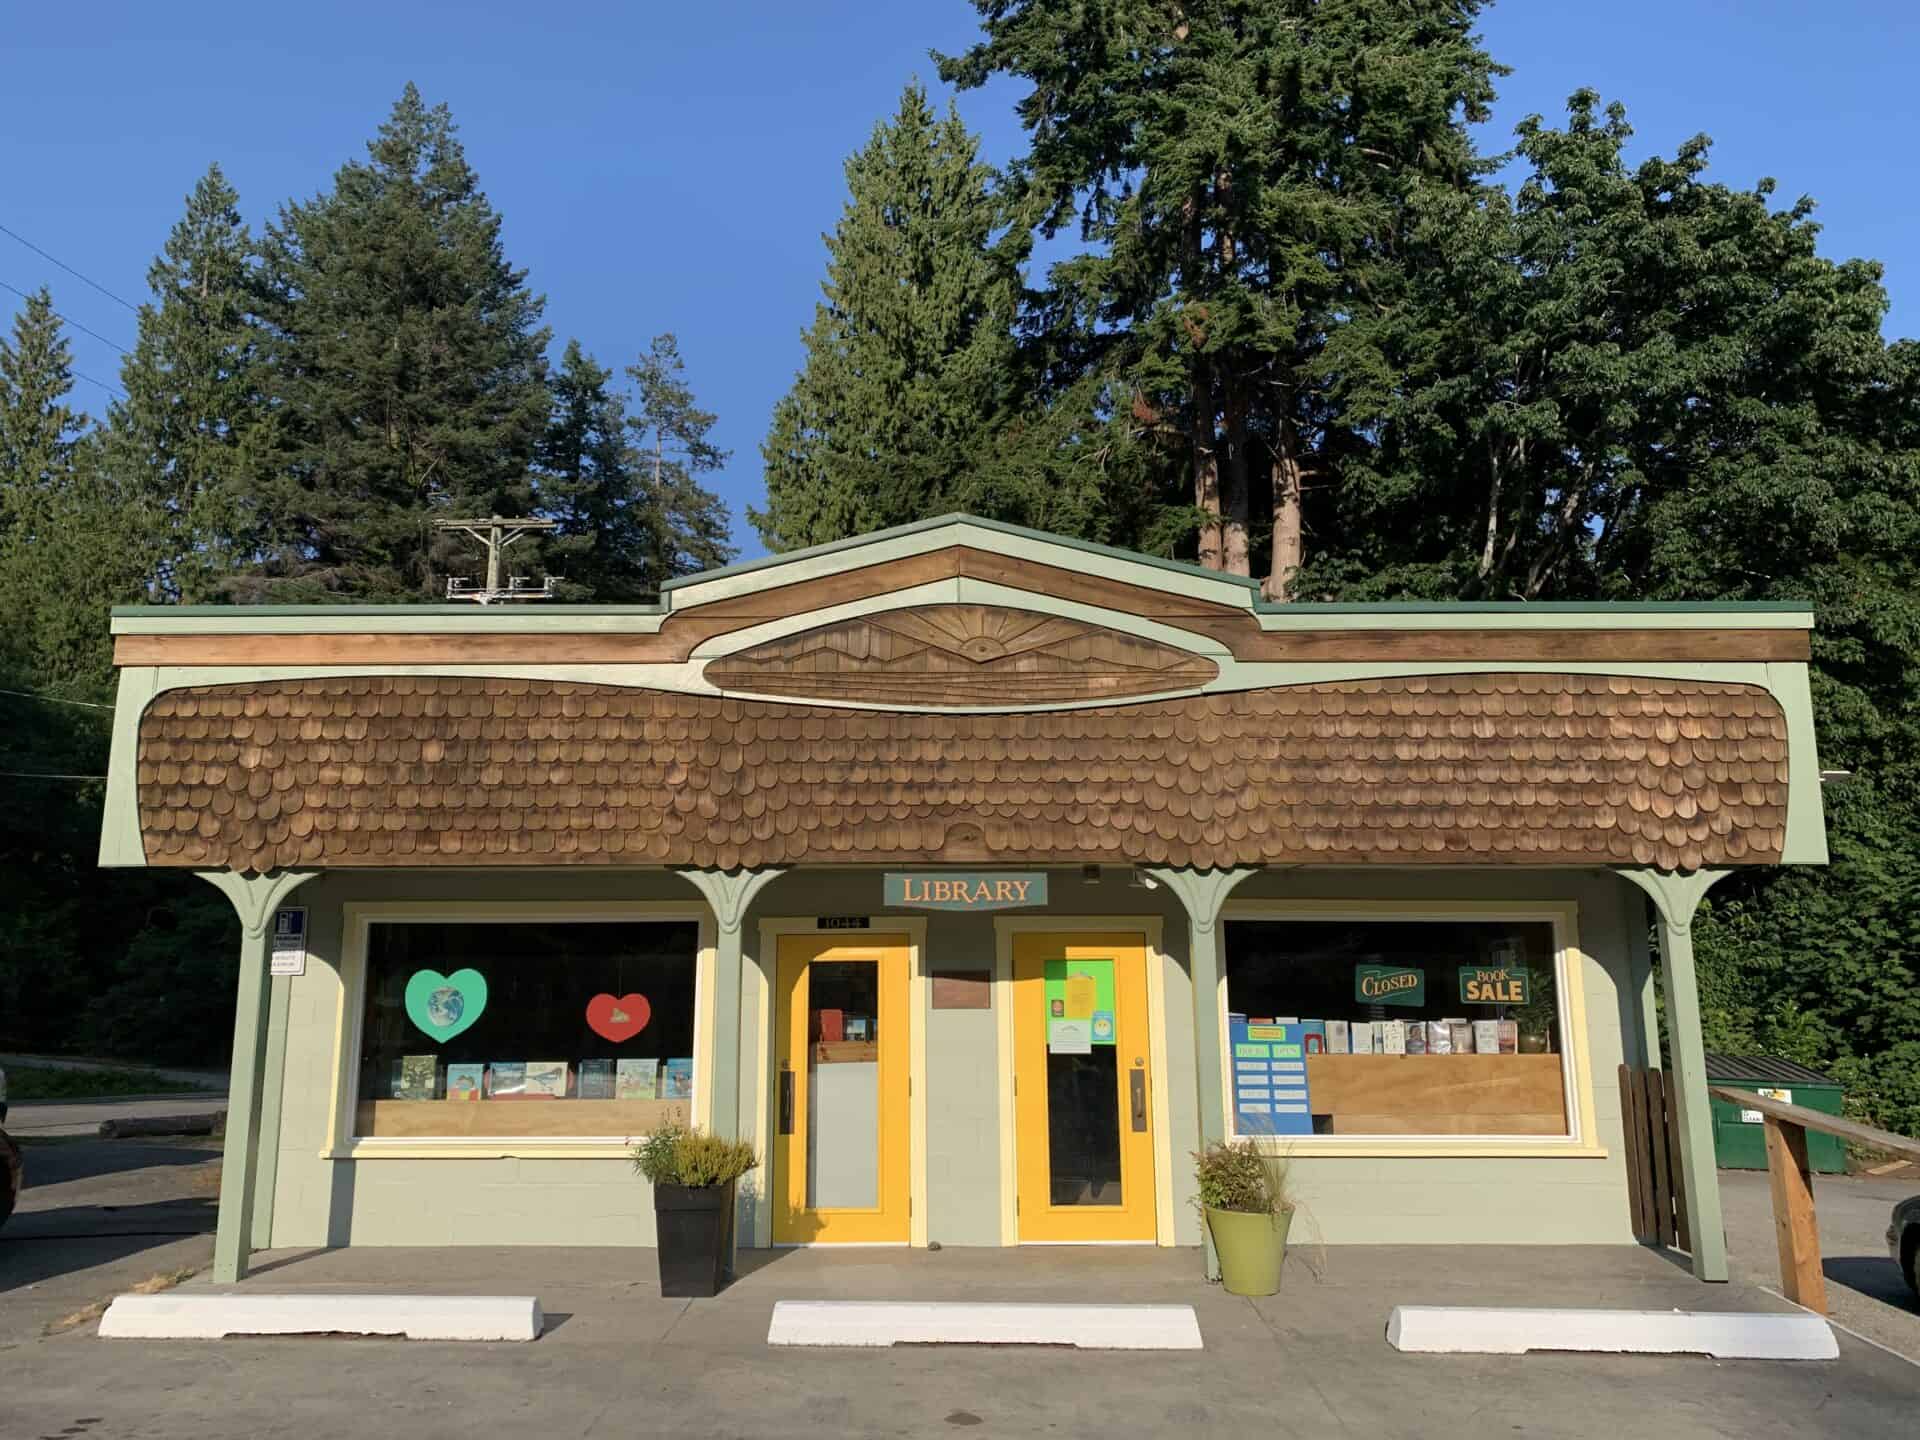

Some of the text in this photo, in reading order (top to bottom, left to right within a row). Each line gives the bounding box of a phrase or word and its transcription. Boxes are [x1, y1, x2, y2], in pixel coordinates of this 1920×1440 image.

[903, 879, 1032, 904] LIBRARY
[1361, 973, 1418, 997] CLOSED
[1476, 967, 1510, 983] BOOK
[1466, 980, 1524, 1001] SALE
